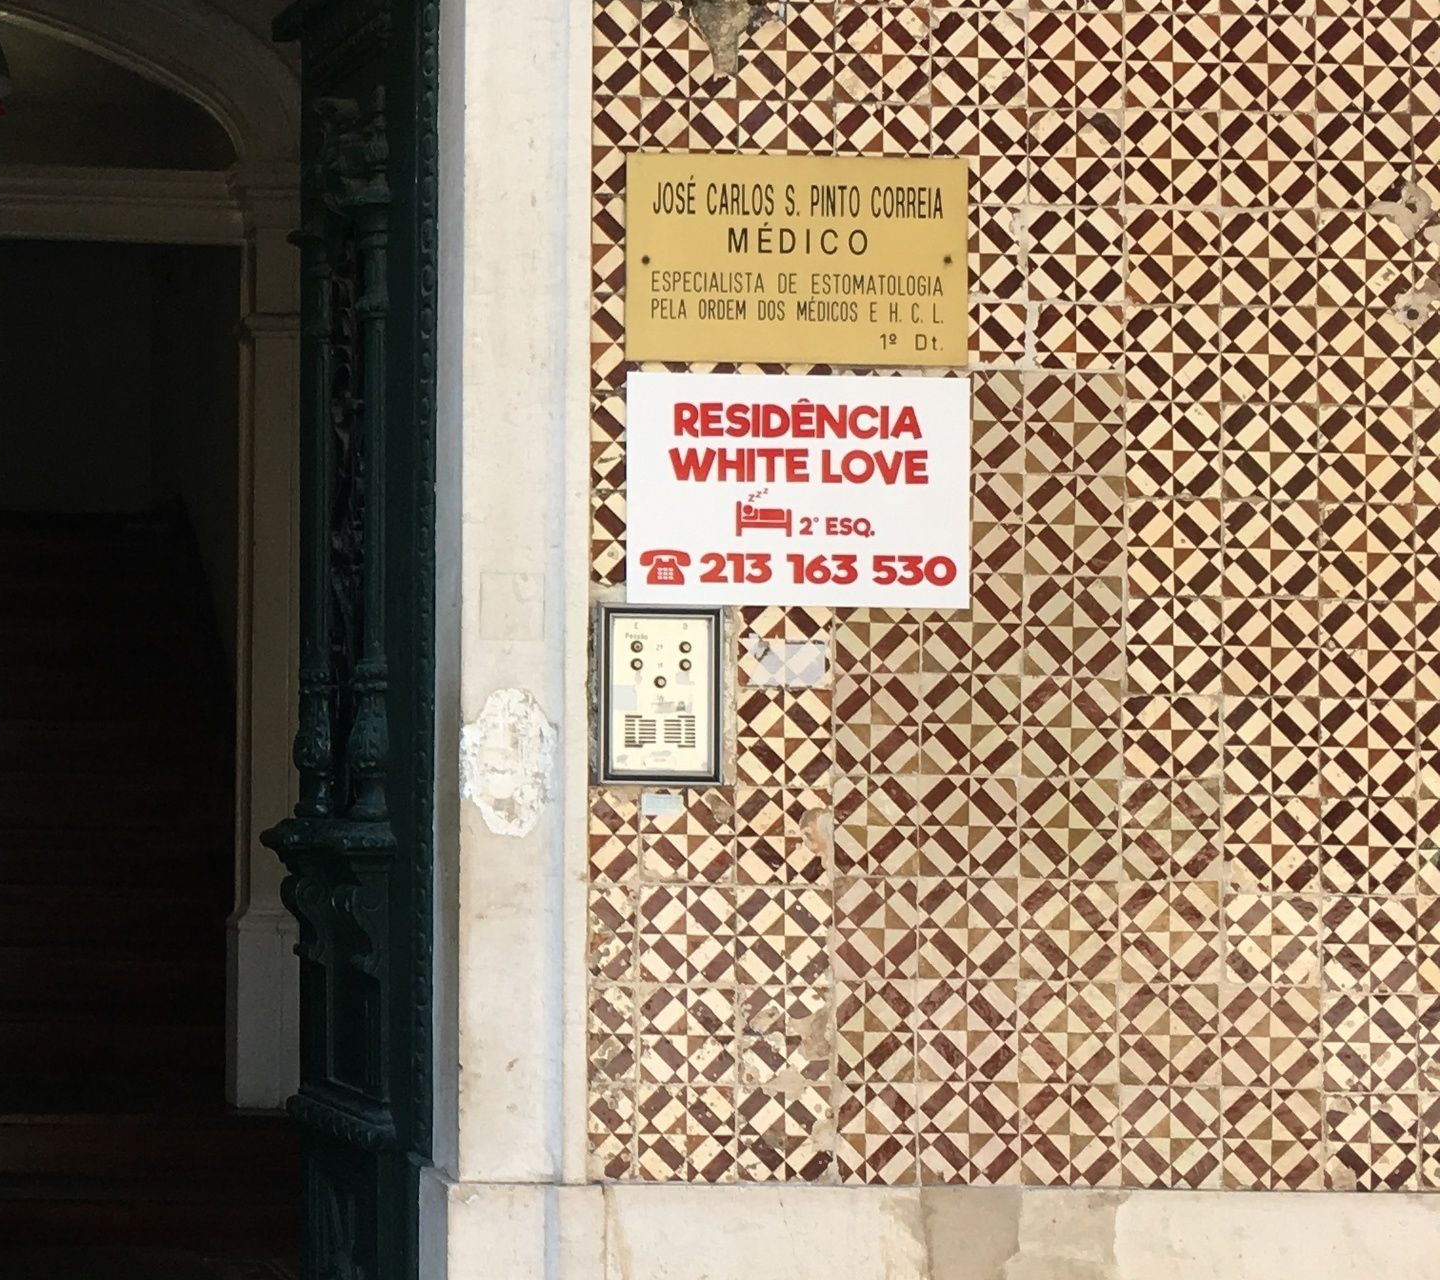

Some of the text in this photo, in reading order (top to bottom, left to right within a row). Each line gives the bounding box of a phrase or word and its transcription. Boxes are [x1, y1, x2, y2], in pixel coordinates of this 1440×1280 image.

[652, 174, 944, 220] JOSÉ CARLOS S. PINTO CORREIA
[727, 221, 868, 256] MÉDICO
[651, 270, 943, 297] ESPECIALISTA DE ESTOMATOLOGIA
[651, 295, 944, 324] PELA ORDEM DOS MÉDICOS E H. C. L.
[673, 398, 922, 440] RESIDÊNCIA
[667, 446, 930, 487] WHITE LOVE
[825, 516, 875, 538] ESQ.
[698, 551, 959, 588] 213 163 530
